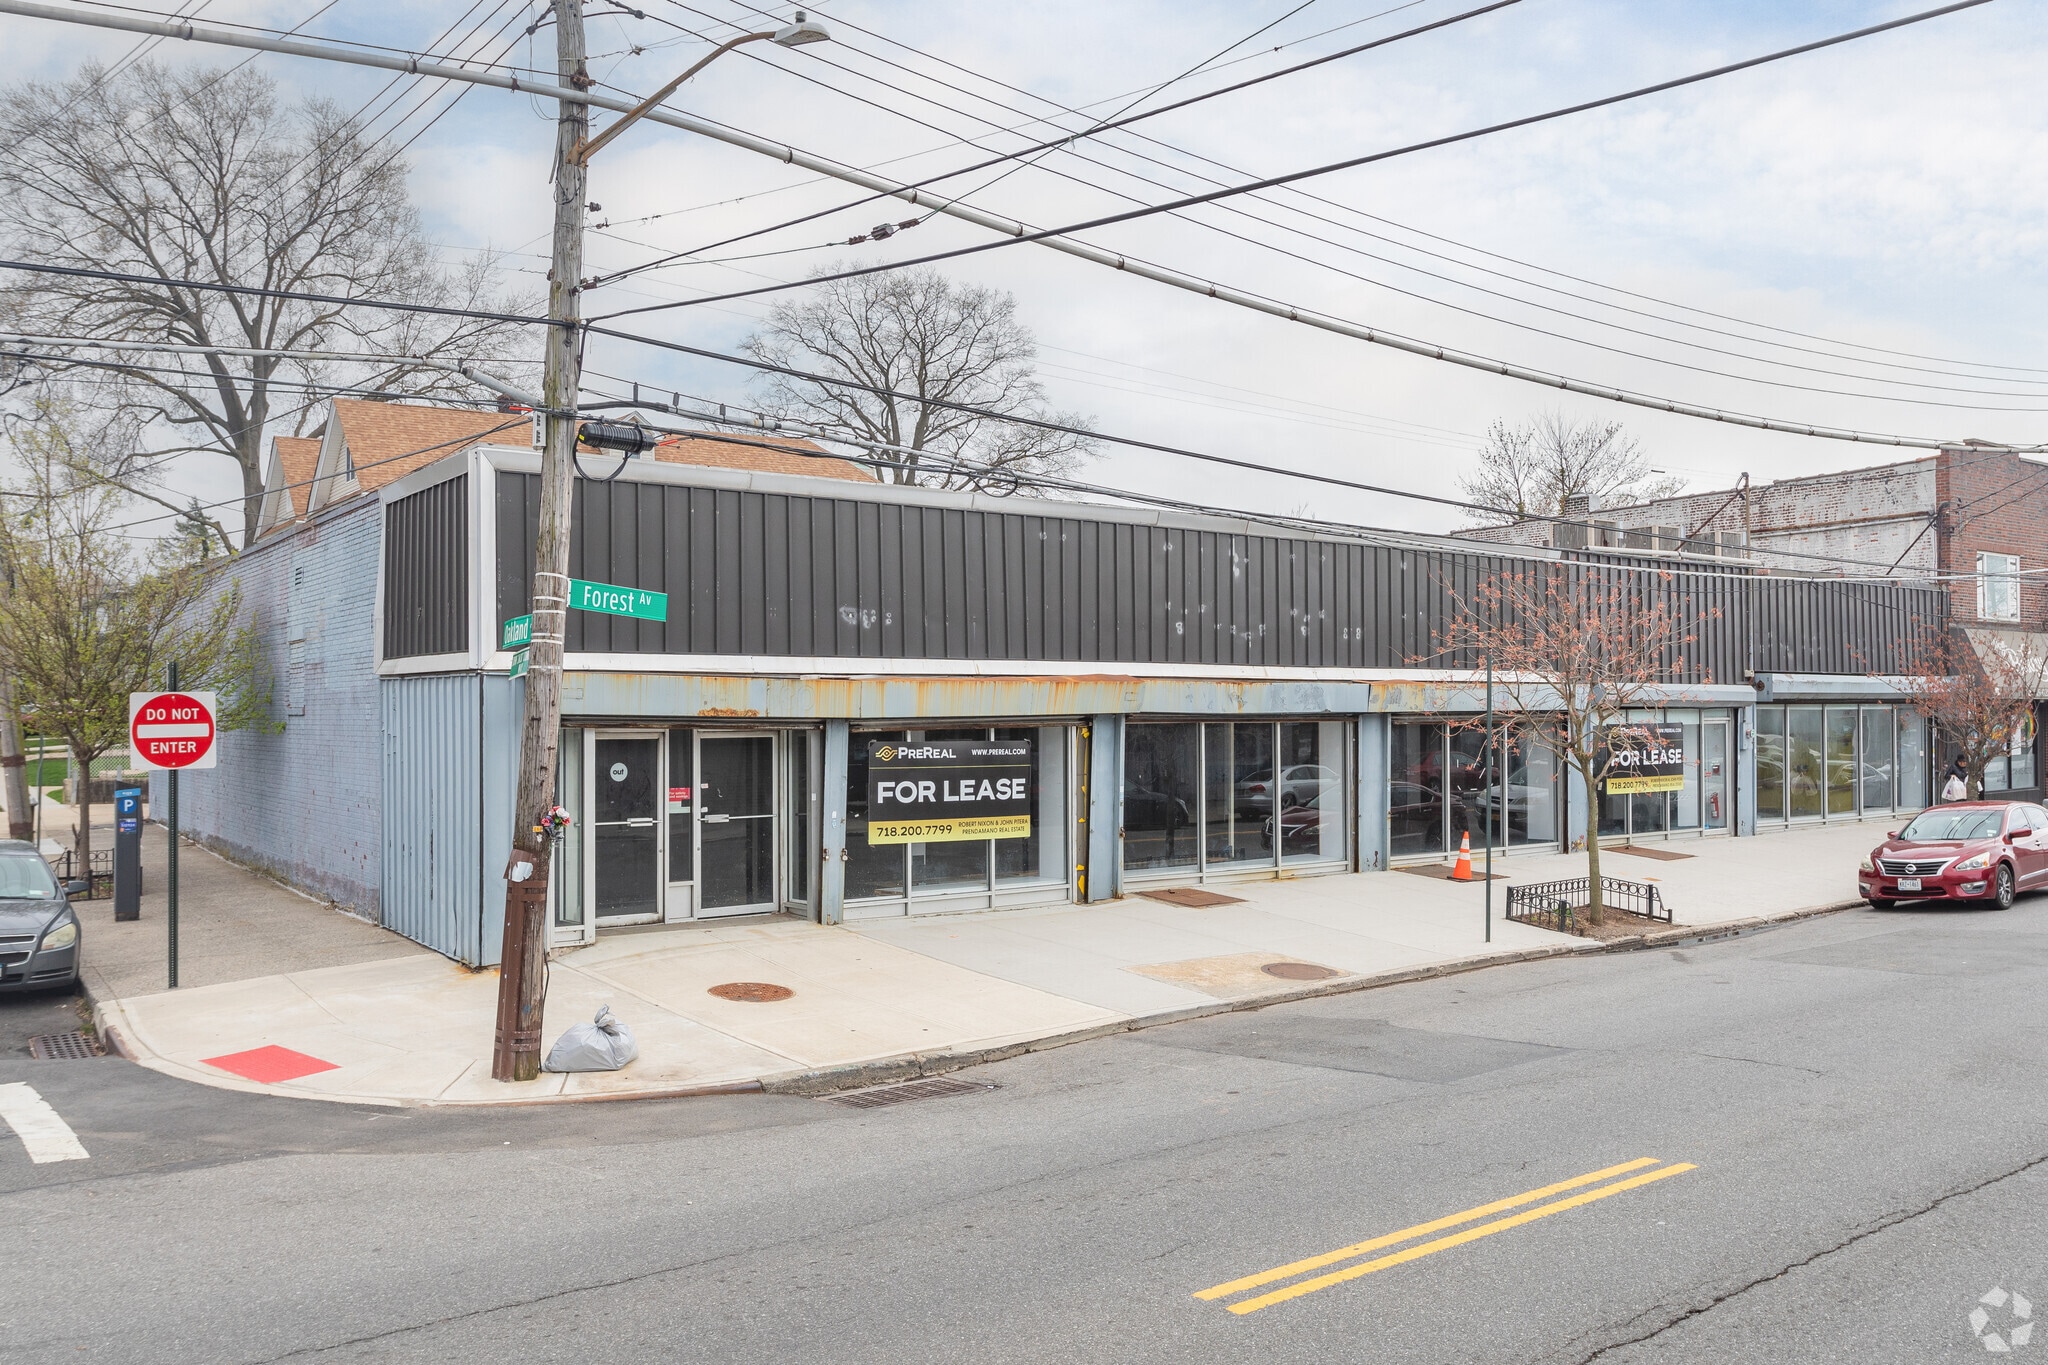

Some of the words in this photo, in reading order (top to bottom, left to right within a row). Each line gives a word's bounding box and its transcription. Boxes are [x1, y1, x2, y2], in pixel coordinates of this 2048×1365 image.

[584, 585, 634, 613] Forest
[639, 592, 652, 606] Av
[504, 617, 529, 644] Oakland
[146, 708, 166, 721] DO
[171, 708, 200, 720] NOT
[150, 741, 197, 755] ENTER
[971, 748, 1026, 756] WWW.PREREAL.COM
[1611, 750, 1640, 767] FOR
[1643, 748, 1682, 765] LEASE
[612, 768, 624, 776] out
[877, 780, 936, 804] FOR
[943, 778, 1026, 802] LEASE
[124, 799, 134, 812] P
[876, 824, 953, 837] 718.200.7799
[958, 820, 977, 828] ROBERT
[962, 827, 998, 835] PRENDAMANO
